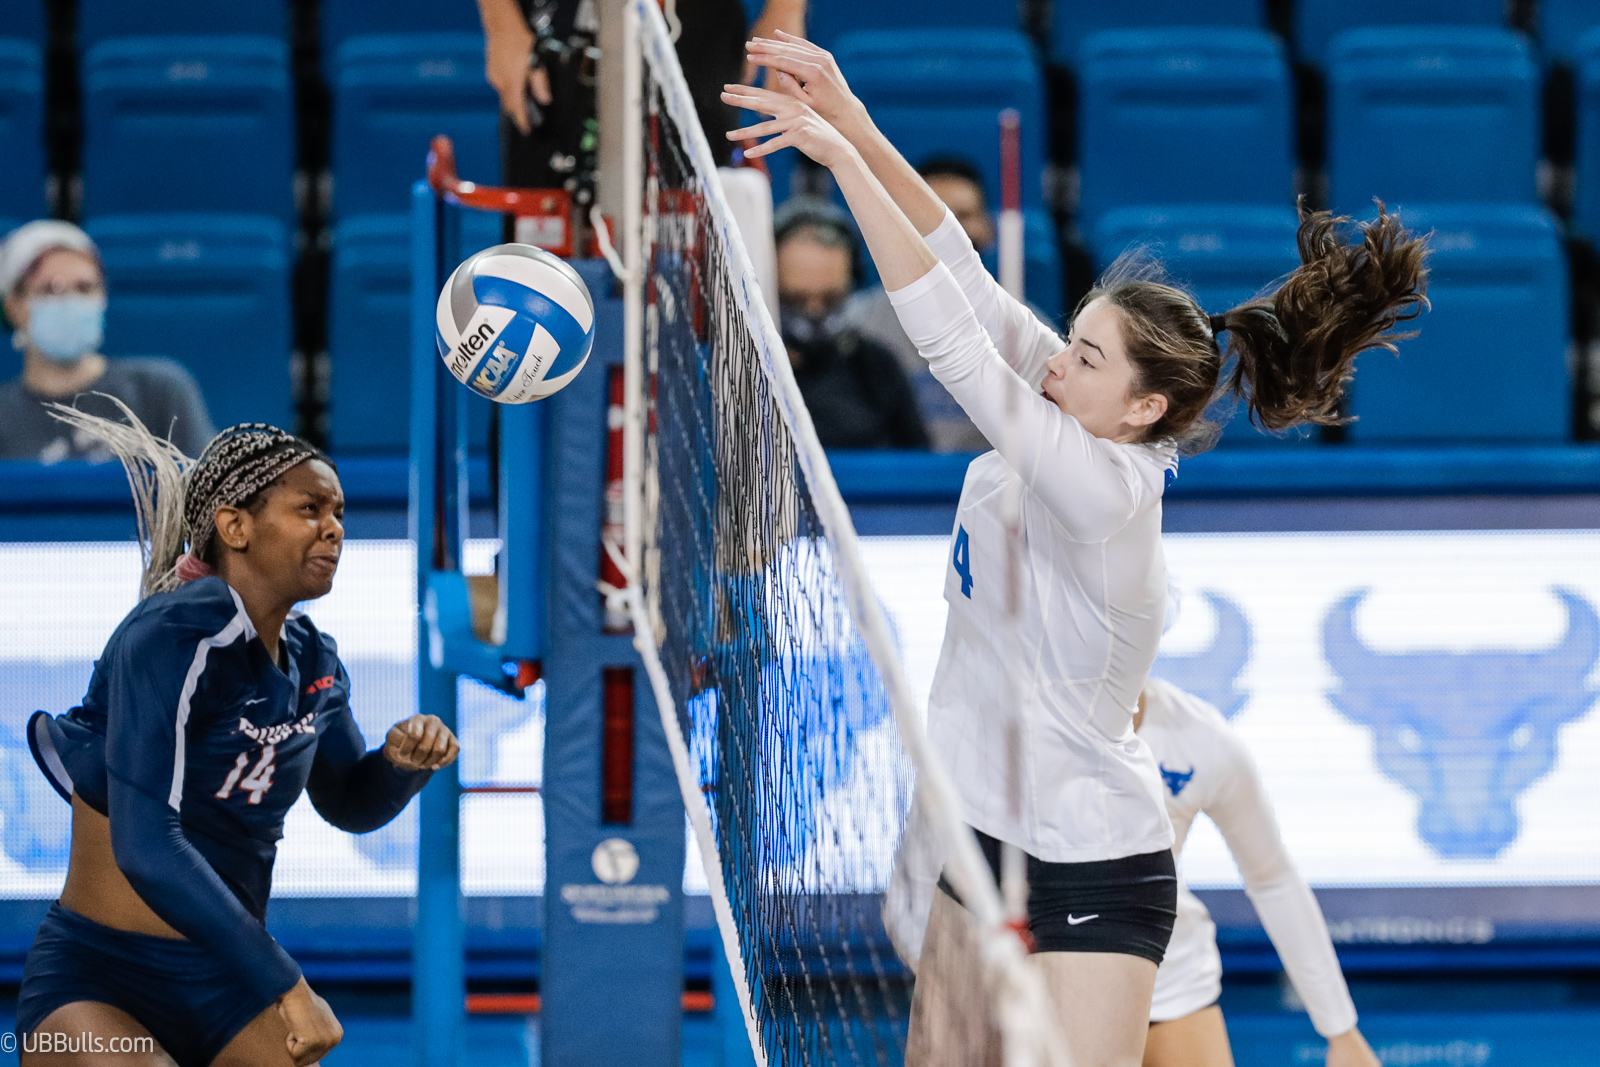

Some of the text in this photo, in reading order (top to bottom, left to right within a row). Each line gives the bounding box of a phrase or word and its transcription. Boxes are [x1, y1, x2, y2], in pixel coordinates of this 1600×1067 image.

[451, 322, 496, 380] molten
[472, 344, 518, 392] NCAA
[521, 354, 543, 388] Touch
[953, 521, 974, 600] 4
[214, 743, 277, 805] 14
